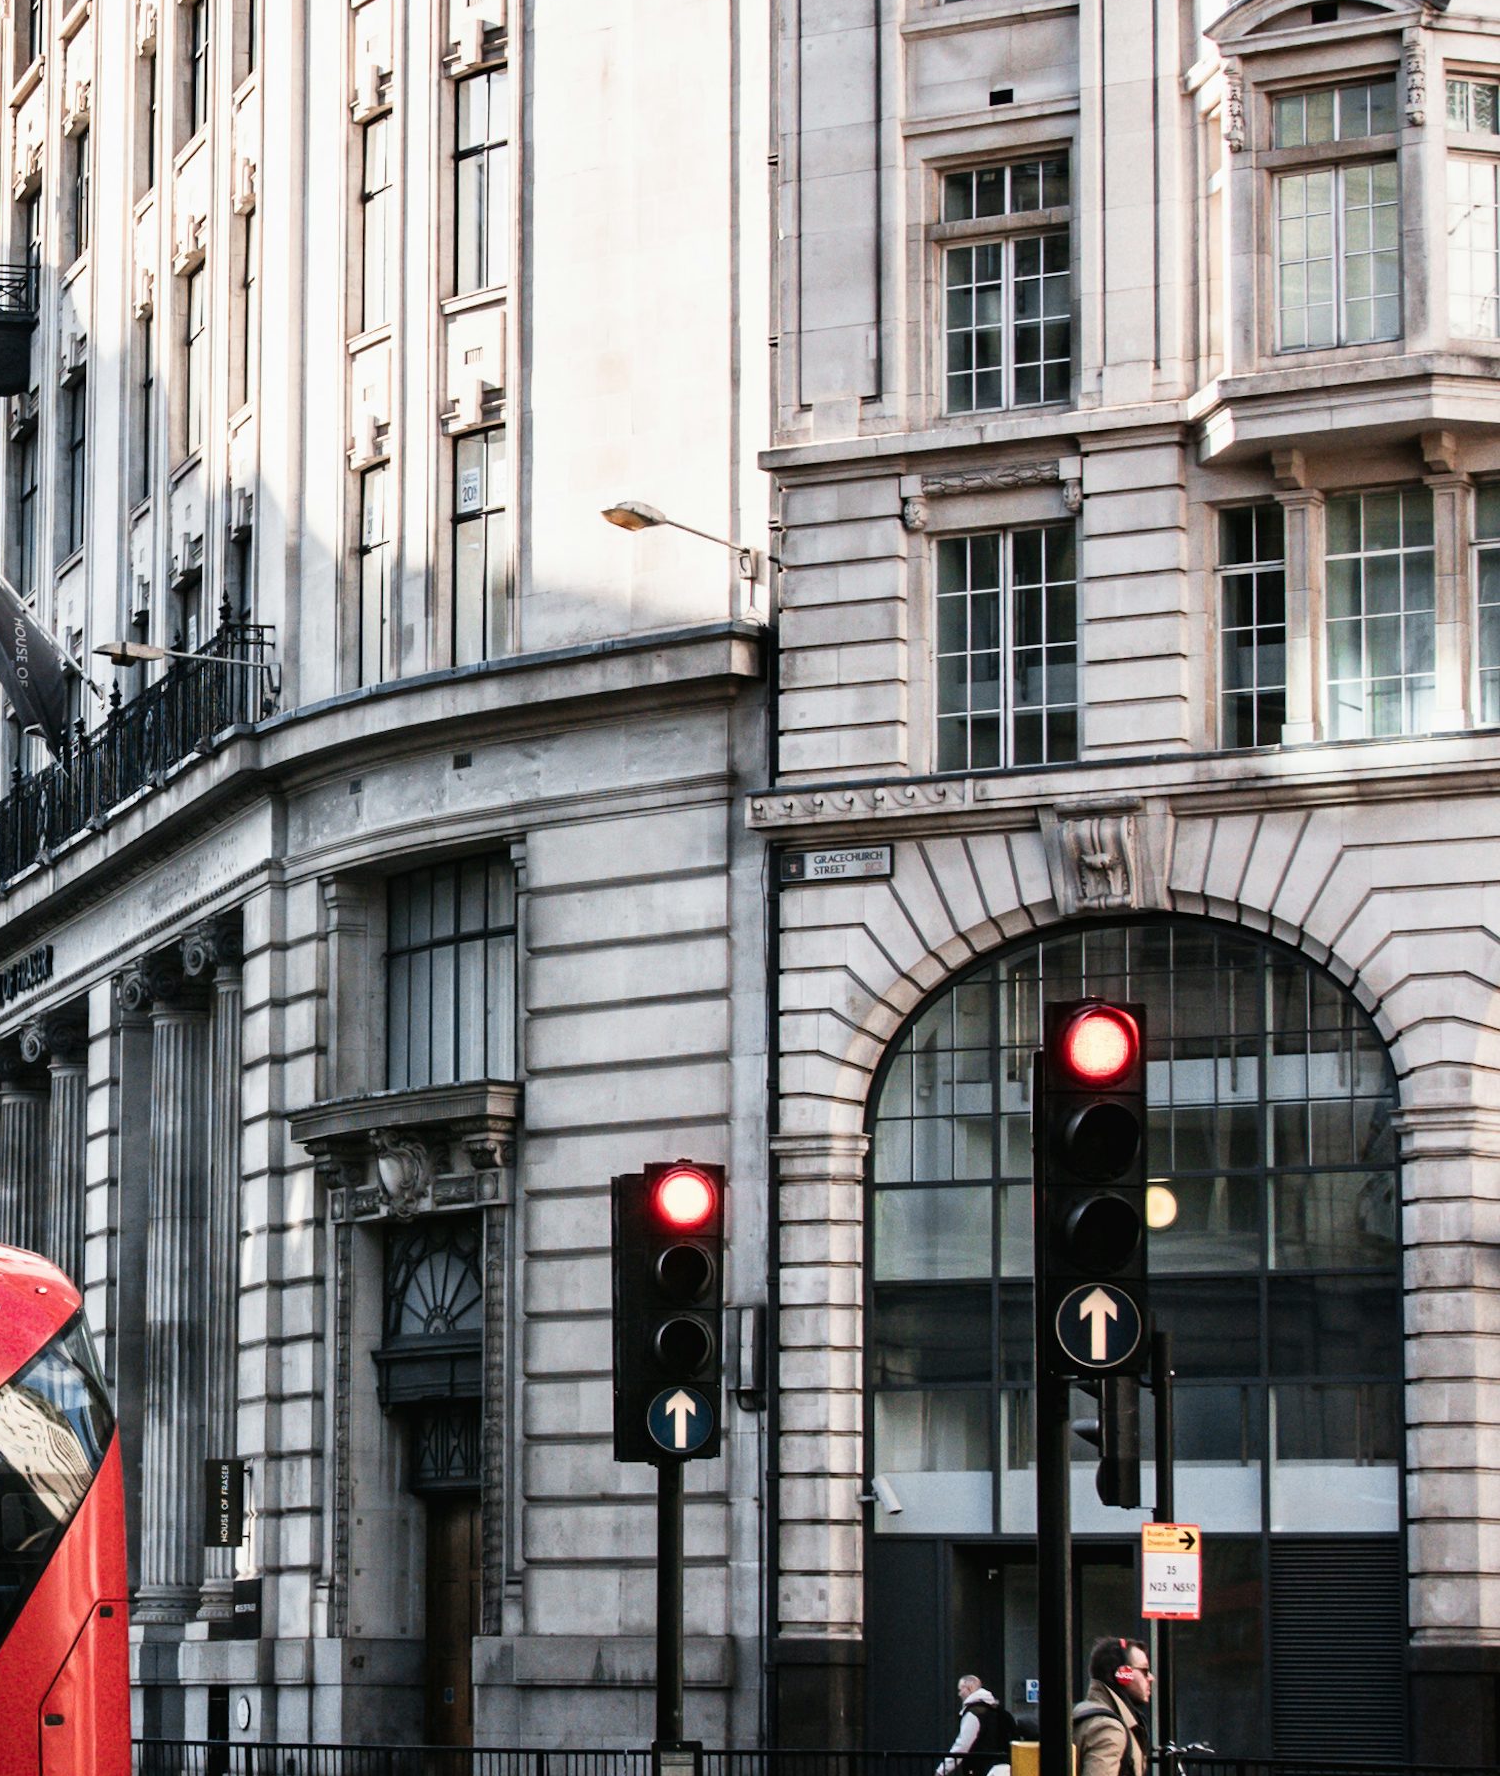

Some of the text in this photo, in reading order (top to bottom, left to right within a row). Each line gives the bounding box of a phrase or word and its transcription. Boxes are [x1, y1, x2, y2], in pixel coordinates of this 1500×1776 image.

[13, 617, 29, 687] HOUSE OF
[814, 851, 883, 864] GRACECHURCH
[813, 864, 847, 875] STREET
[220, 1464, 229, 1543] HOUSE OF FRASER
[1149, 1582, 1167, 1592] N25
